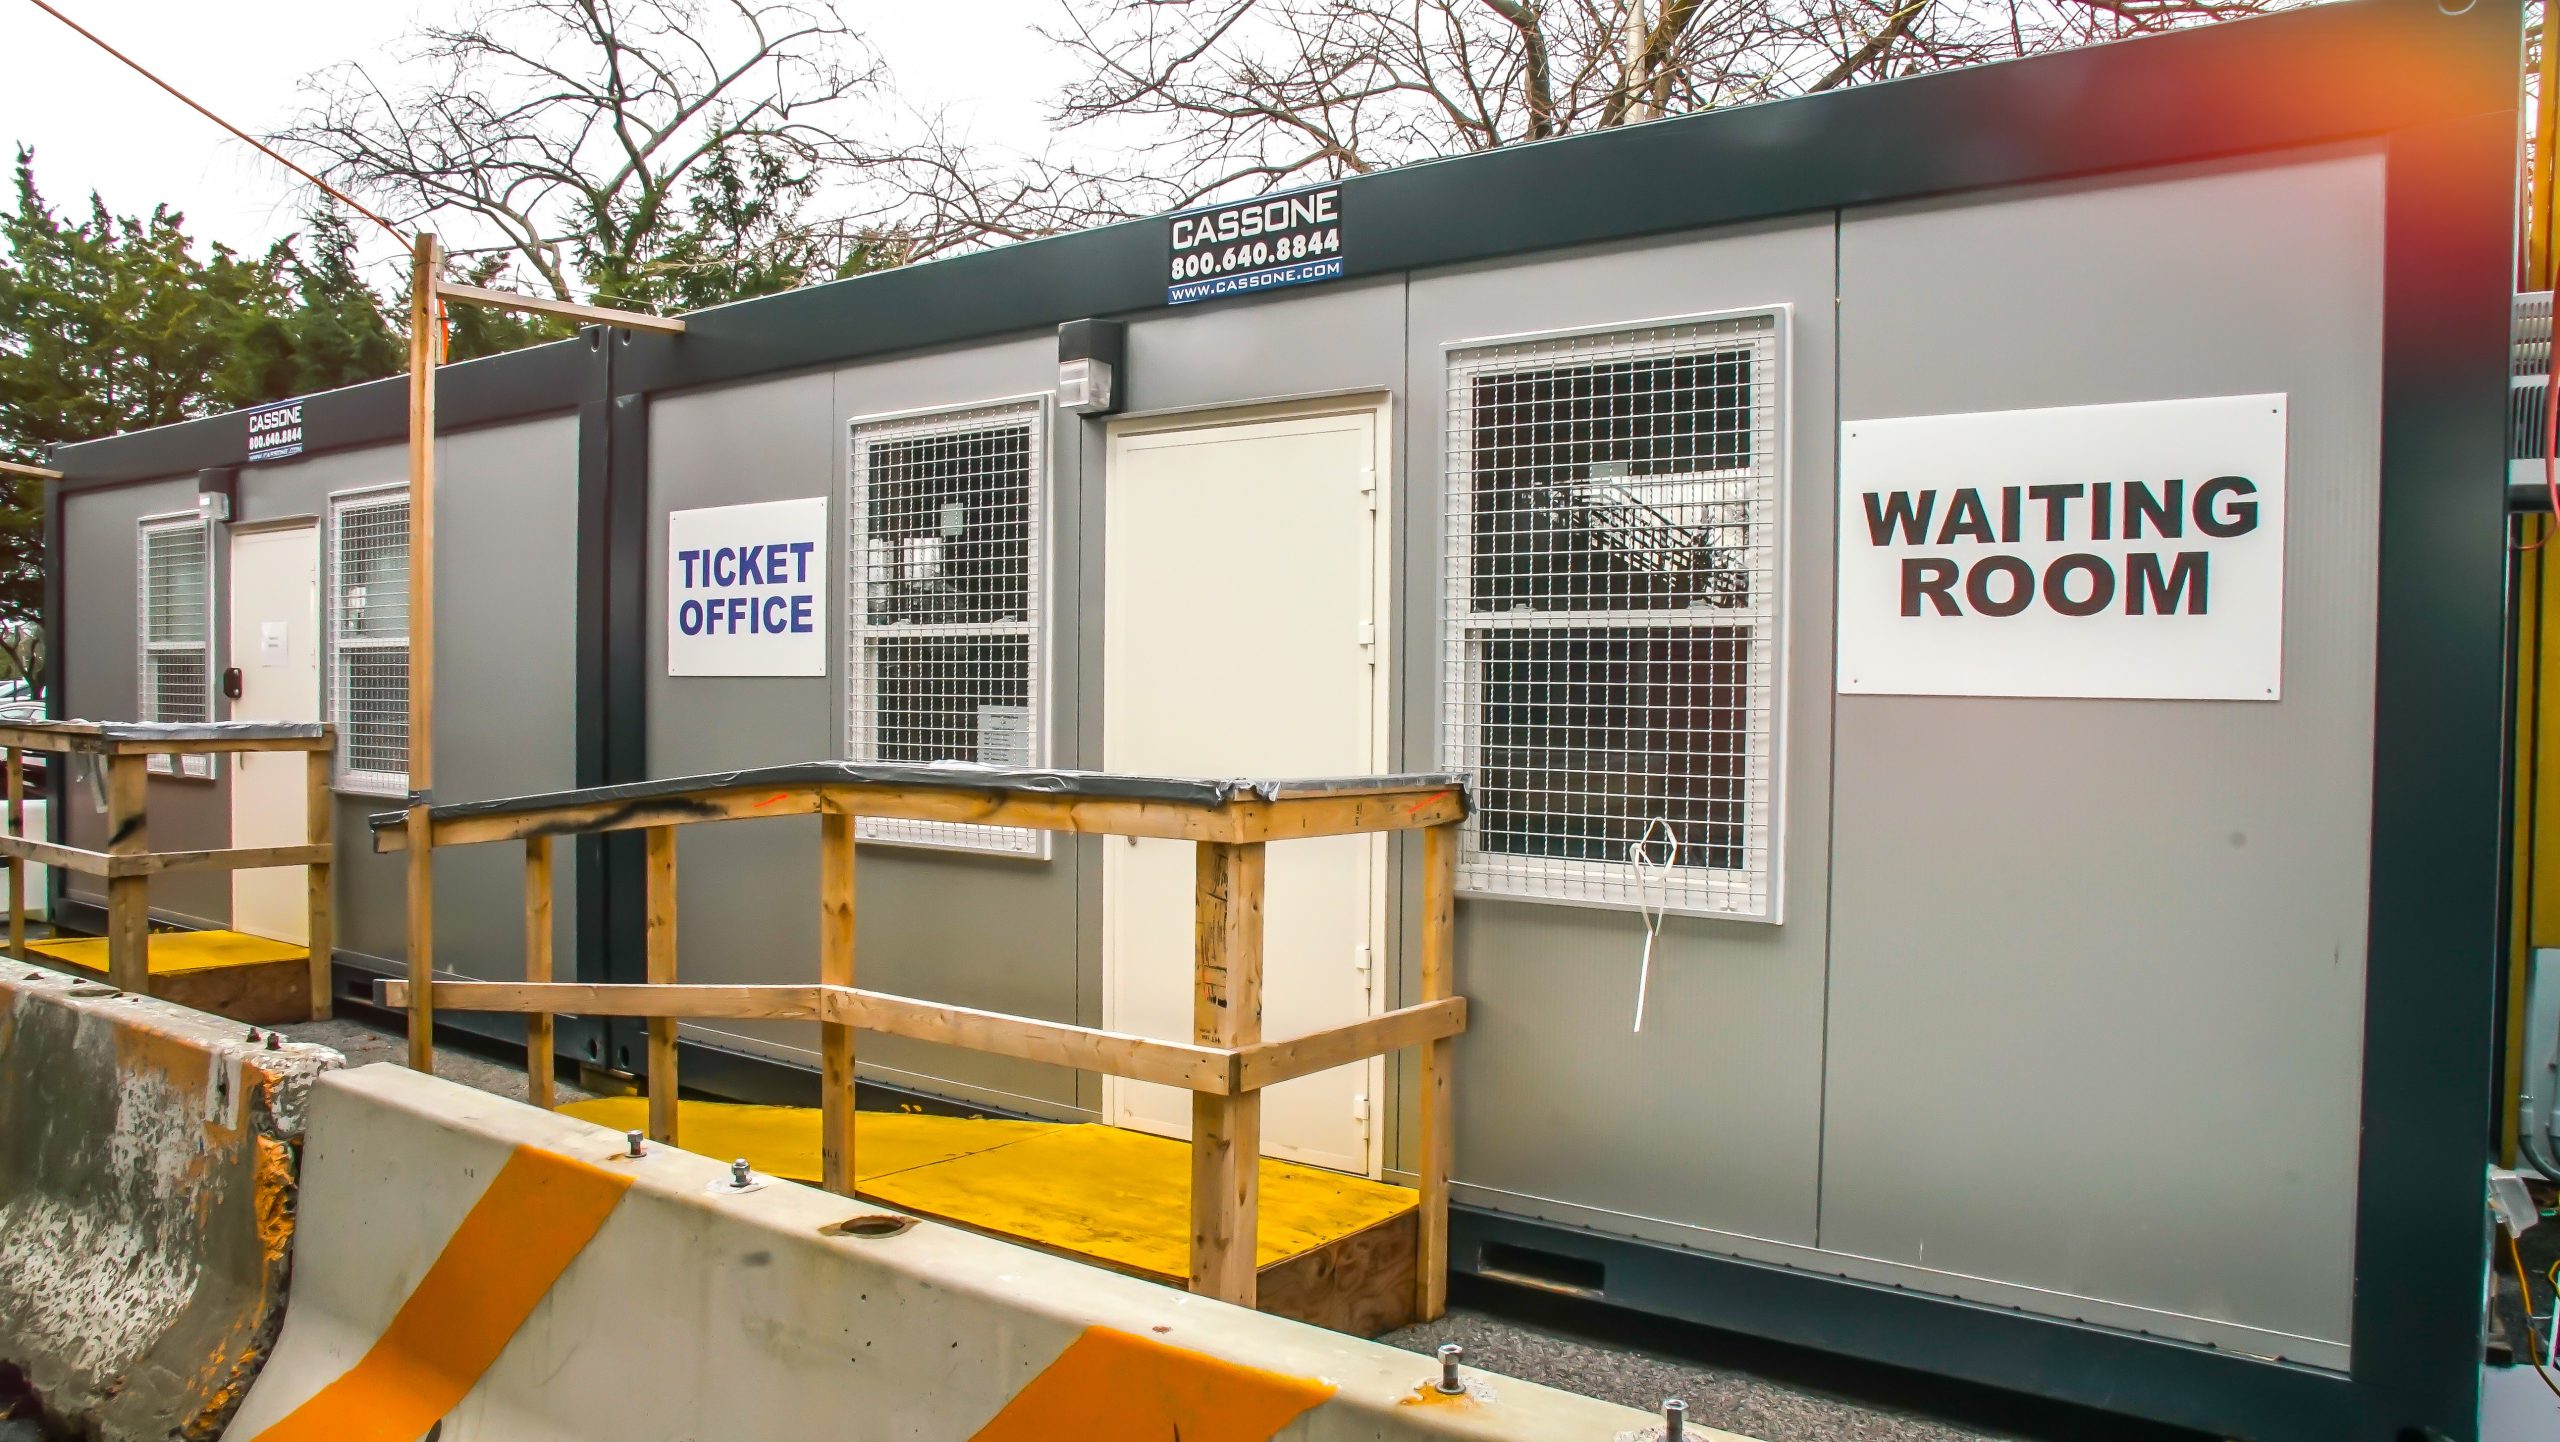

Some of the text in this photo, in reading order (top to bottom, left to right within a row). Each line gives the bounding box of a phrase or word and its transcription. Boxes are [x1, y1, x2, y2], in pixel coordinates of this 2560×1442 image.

[1172, 190, 1338, 250] CASSONE
[1171, 228, 1339, 280] 800.640.8844
[1172, 262, 1340, 300] WWW.CASSONE.COM
[249, 405, 302, 433] CASSONE
[1862, 475, 2259, 547] WAITING
[678, 541, 814, 589] TICKET
[1900, 551, 2209, 617] ROOM
[679, 595, 813, 636] OFFICE
